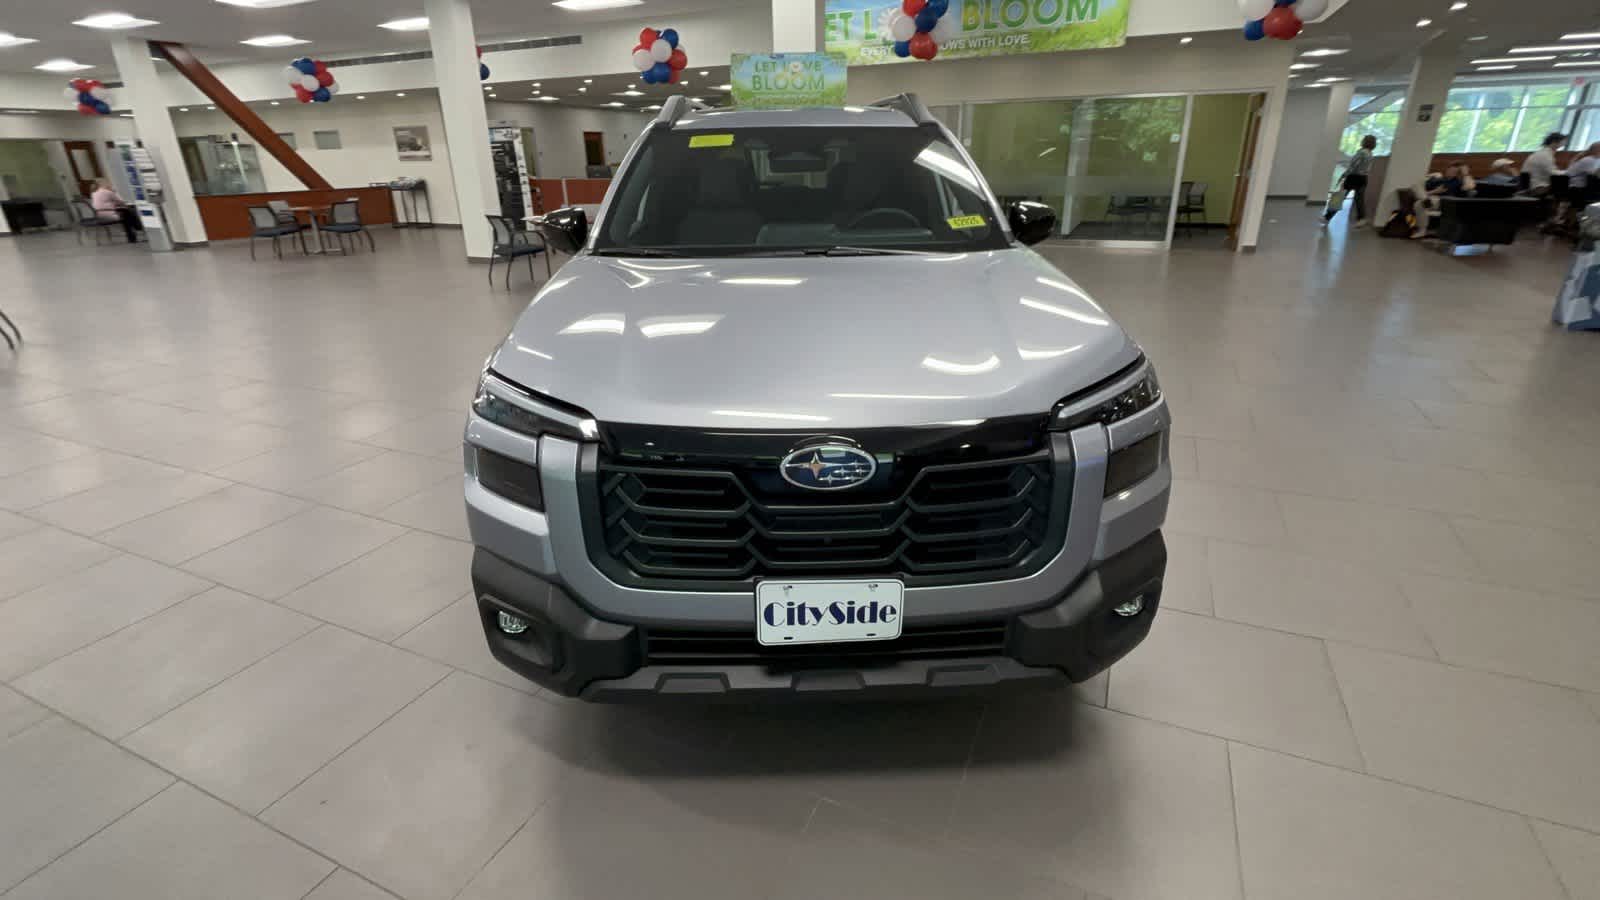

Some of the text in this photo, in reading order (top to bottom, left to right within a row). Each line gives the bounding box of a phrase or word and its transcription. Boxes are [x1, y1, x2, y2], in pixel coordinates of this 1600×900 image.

[825, 10, 853, 41] ET
[962, 0, 1098, 31] BLOOM
[941, 38, 966, 49] OWS
[968, 37, 996, 48] WITH
[755, 61, 777, 72] LET
[752, 73, 825, 90] BLOOM
[763, 601, 897, 627] CitySide
